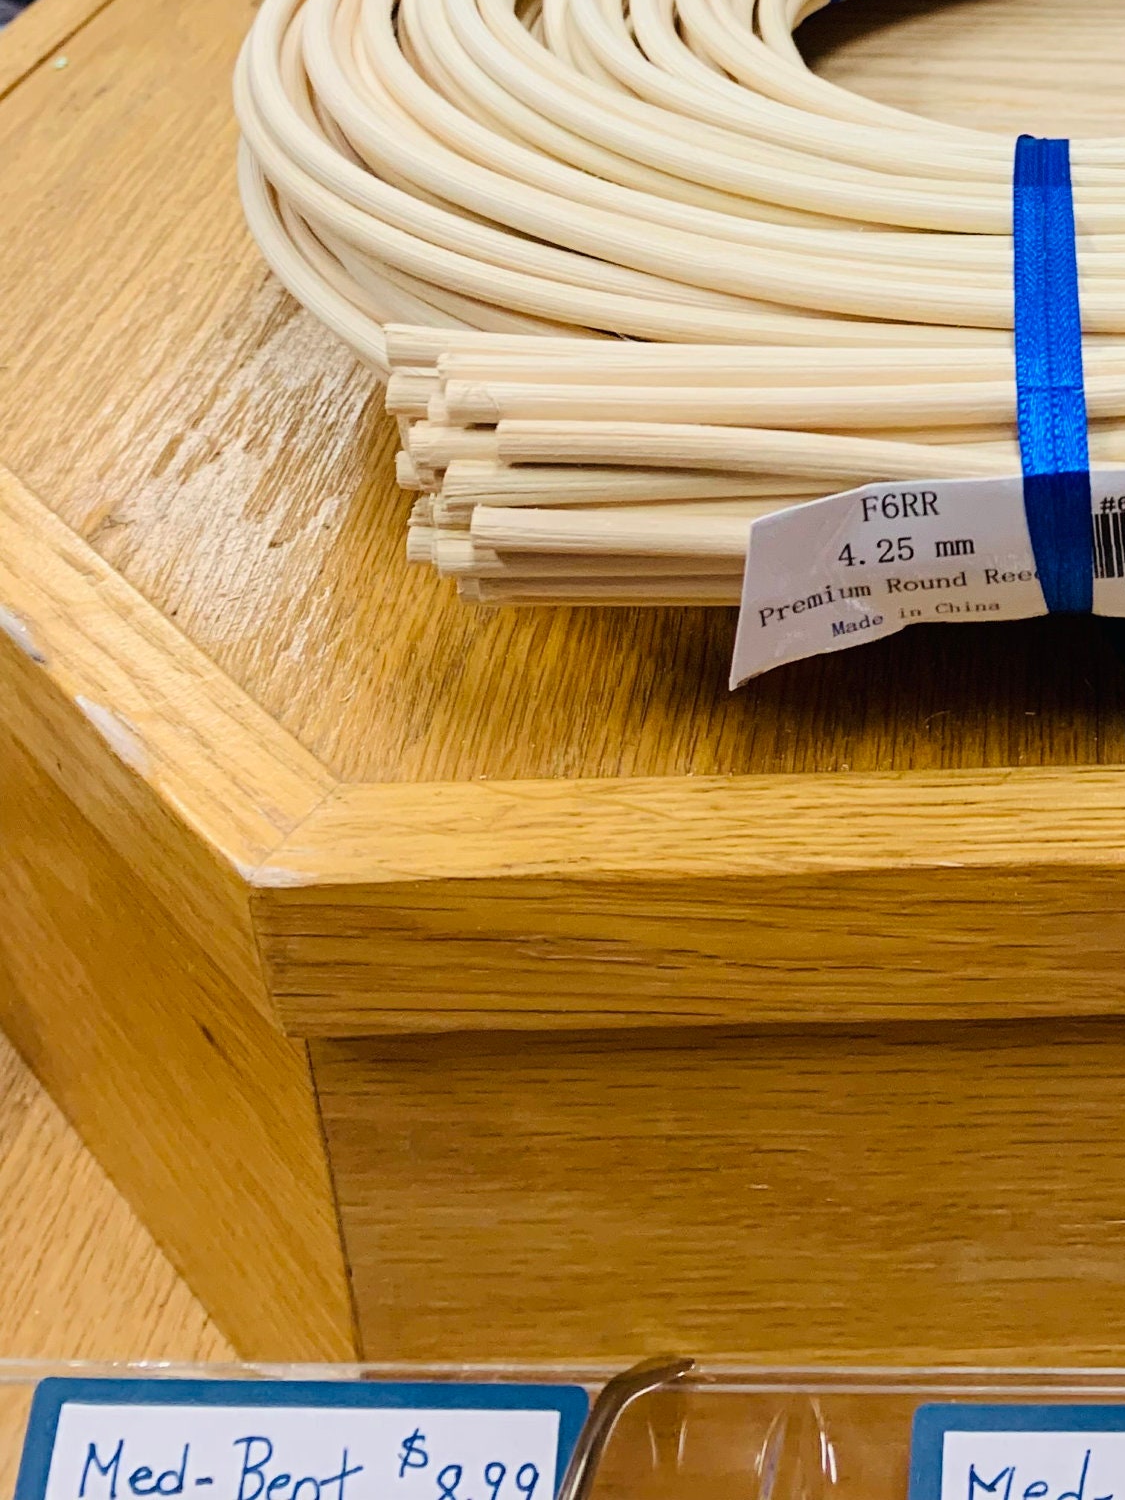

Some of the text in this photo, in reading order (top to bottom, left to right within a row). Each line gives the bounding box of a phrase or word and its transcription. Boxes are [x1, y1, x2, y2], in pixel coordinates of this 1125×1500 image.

[861, 490, 941, 523] F6RR
[837, 536, 976, 567] 4.25 mm
[758, 584, 872, 628] Premium
[887, 571, 968, 594] Round
[831, 599, 1001, 638] Made in China
